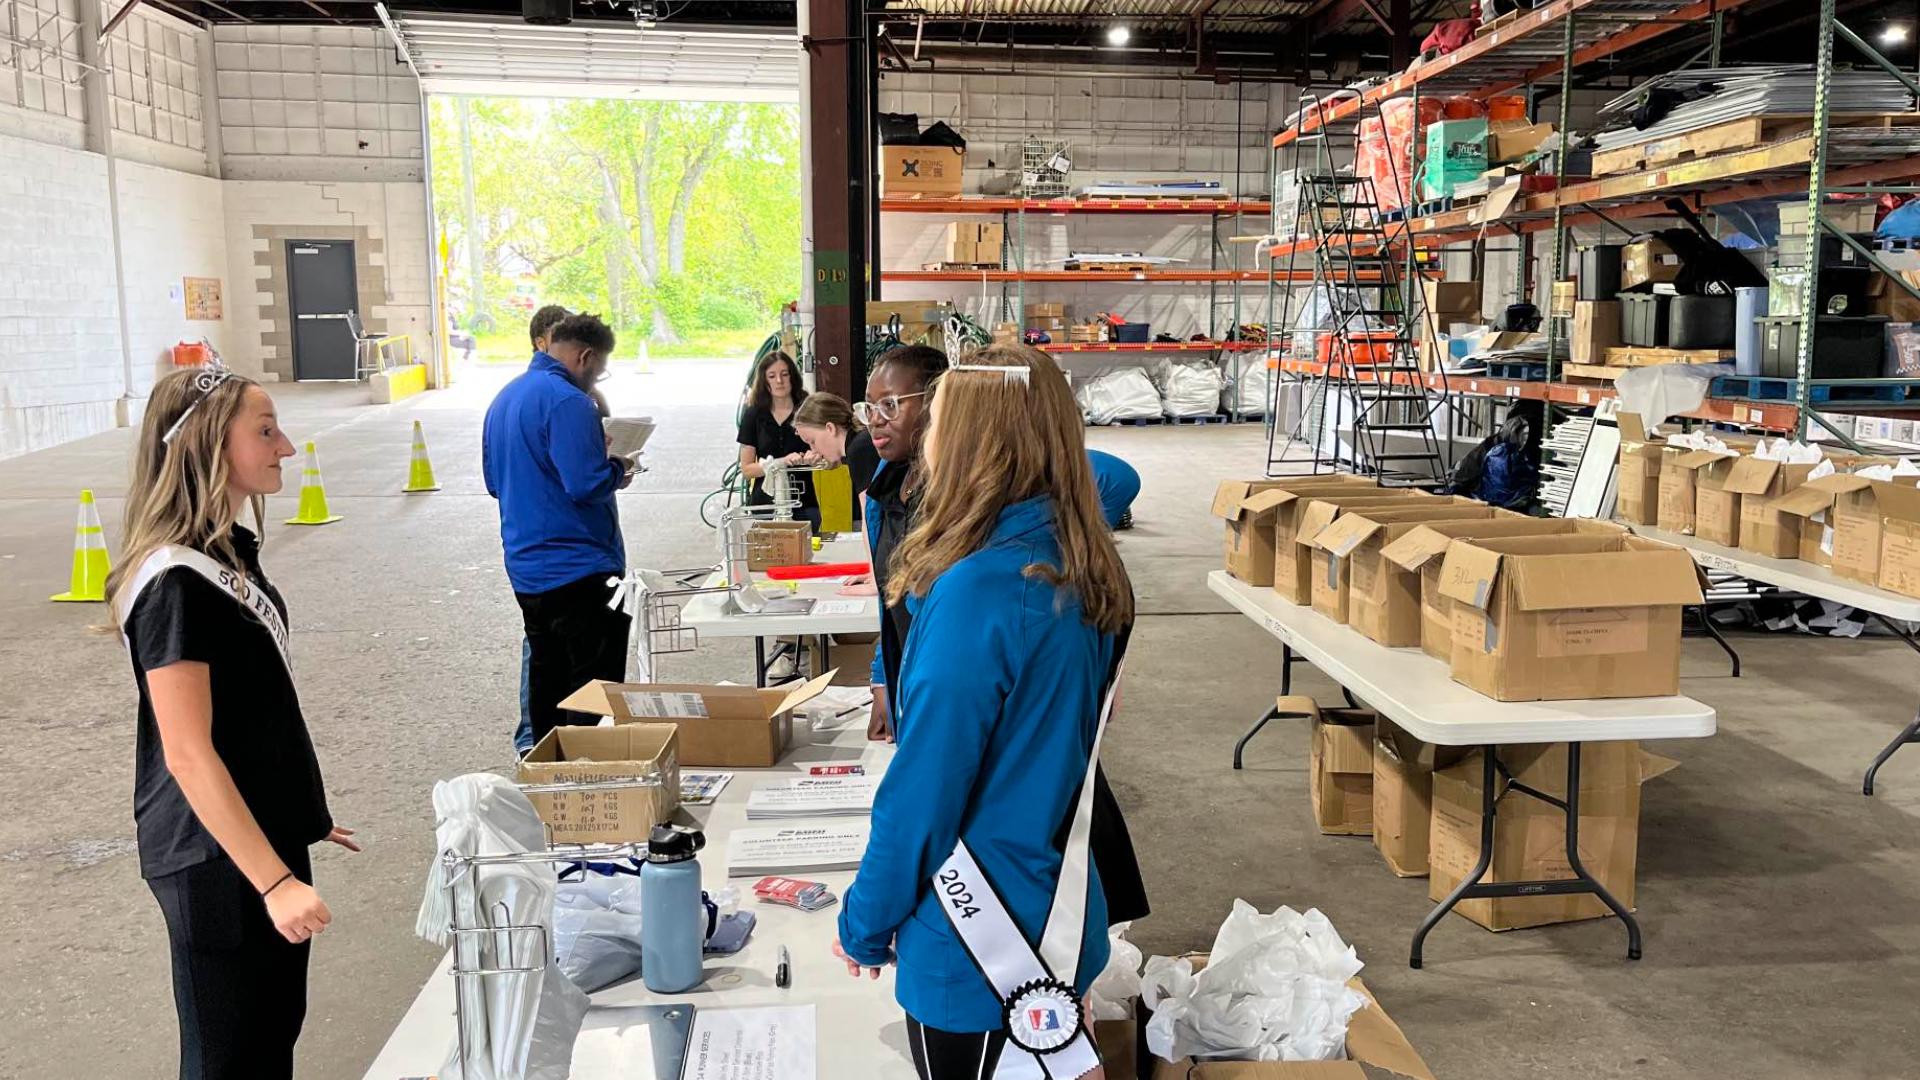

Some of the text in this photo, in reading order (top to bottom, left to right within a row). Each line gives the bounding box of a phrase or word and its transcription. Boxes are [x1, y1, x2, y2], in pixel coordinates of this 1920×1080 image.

[818, 269, 826, 281] D
[219, 570, 251, 601] 500
[602, 792, 618, 800] PCS
[939, 869, 981, 918] 2024
